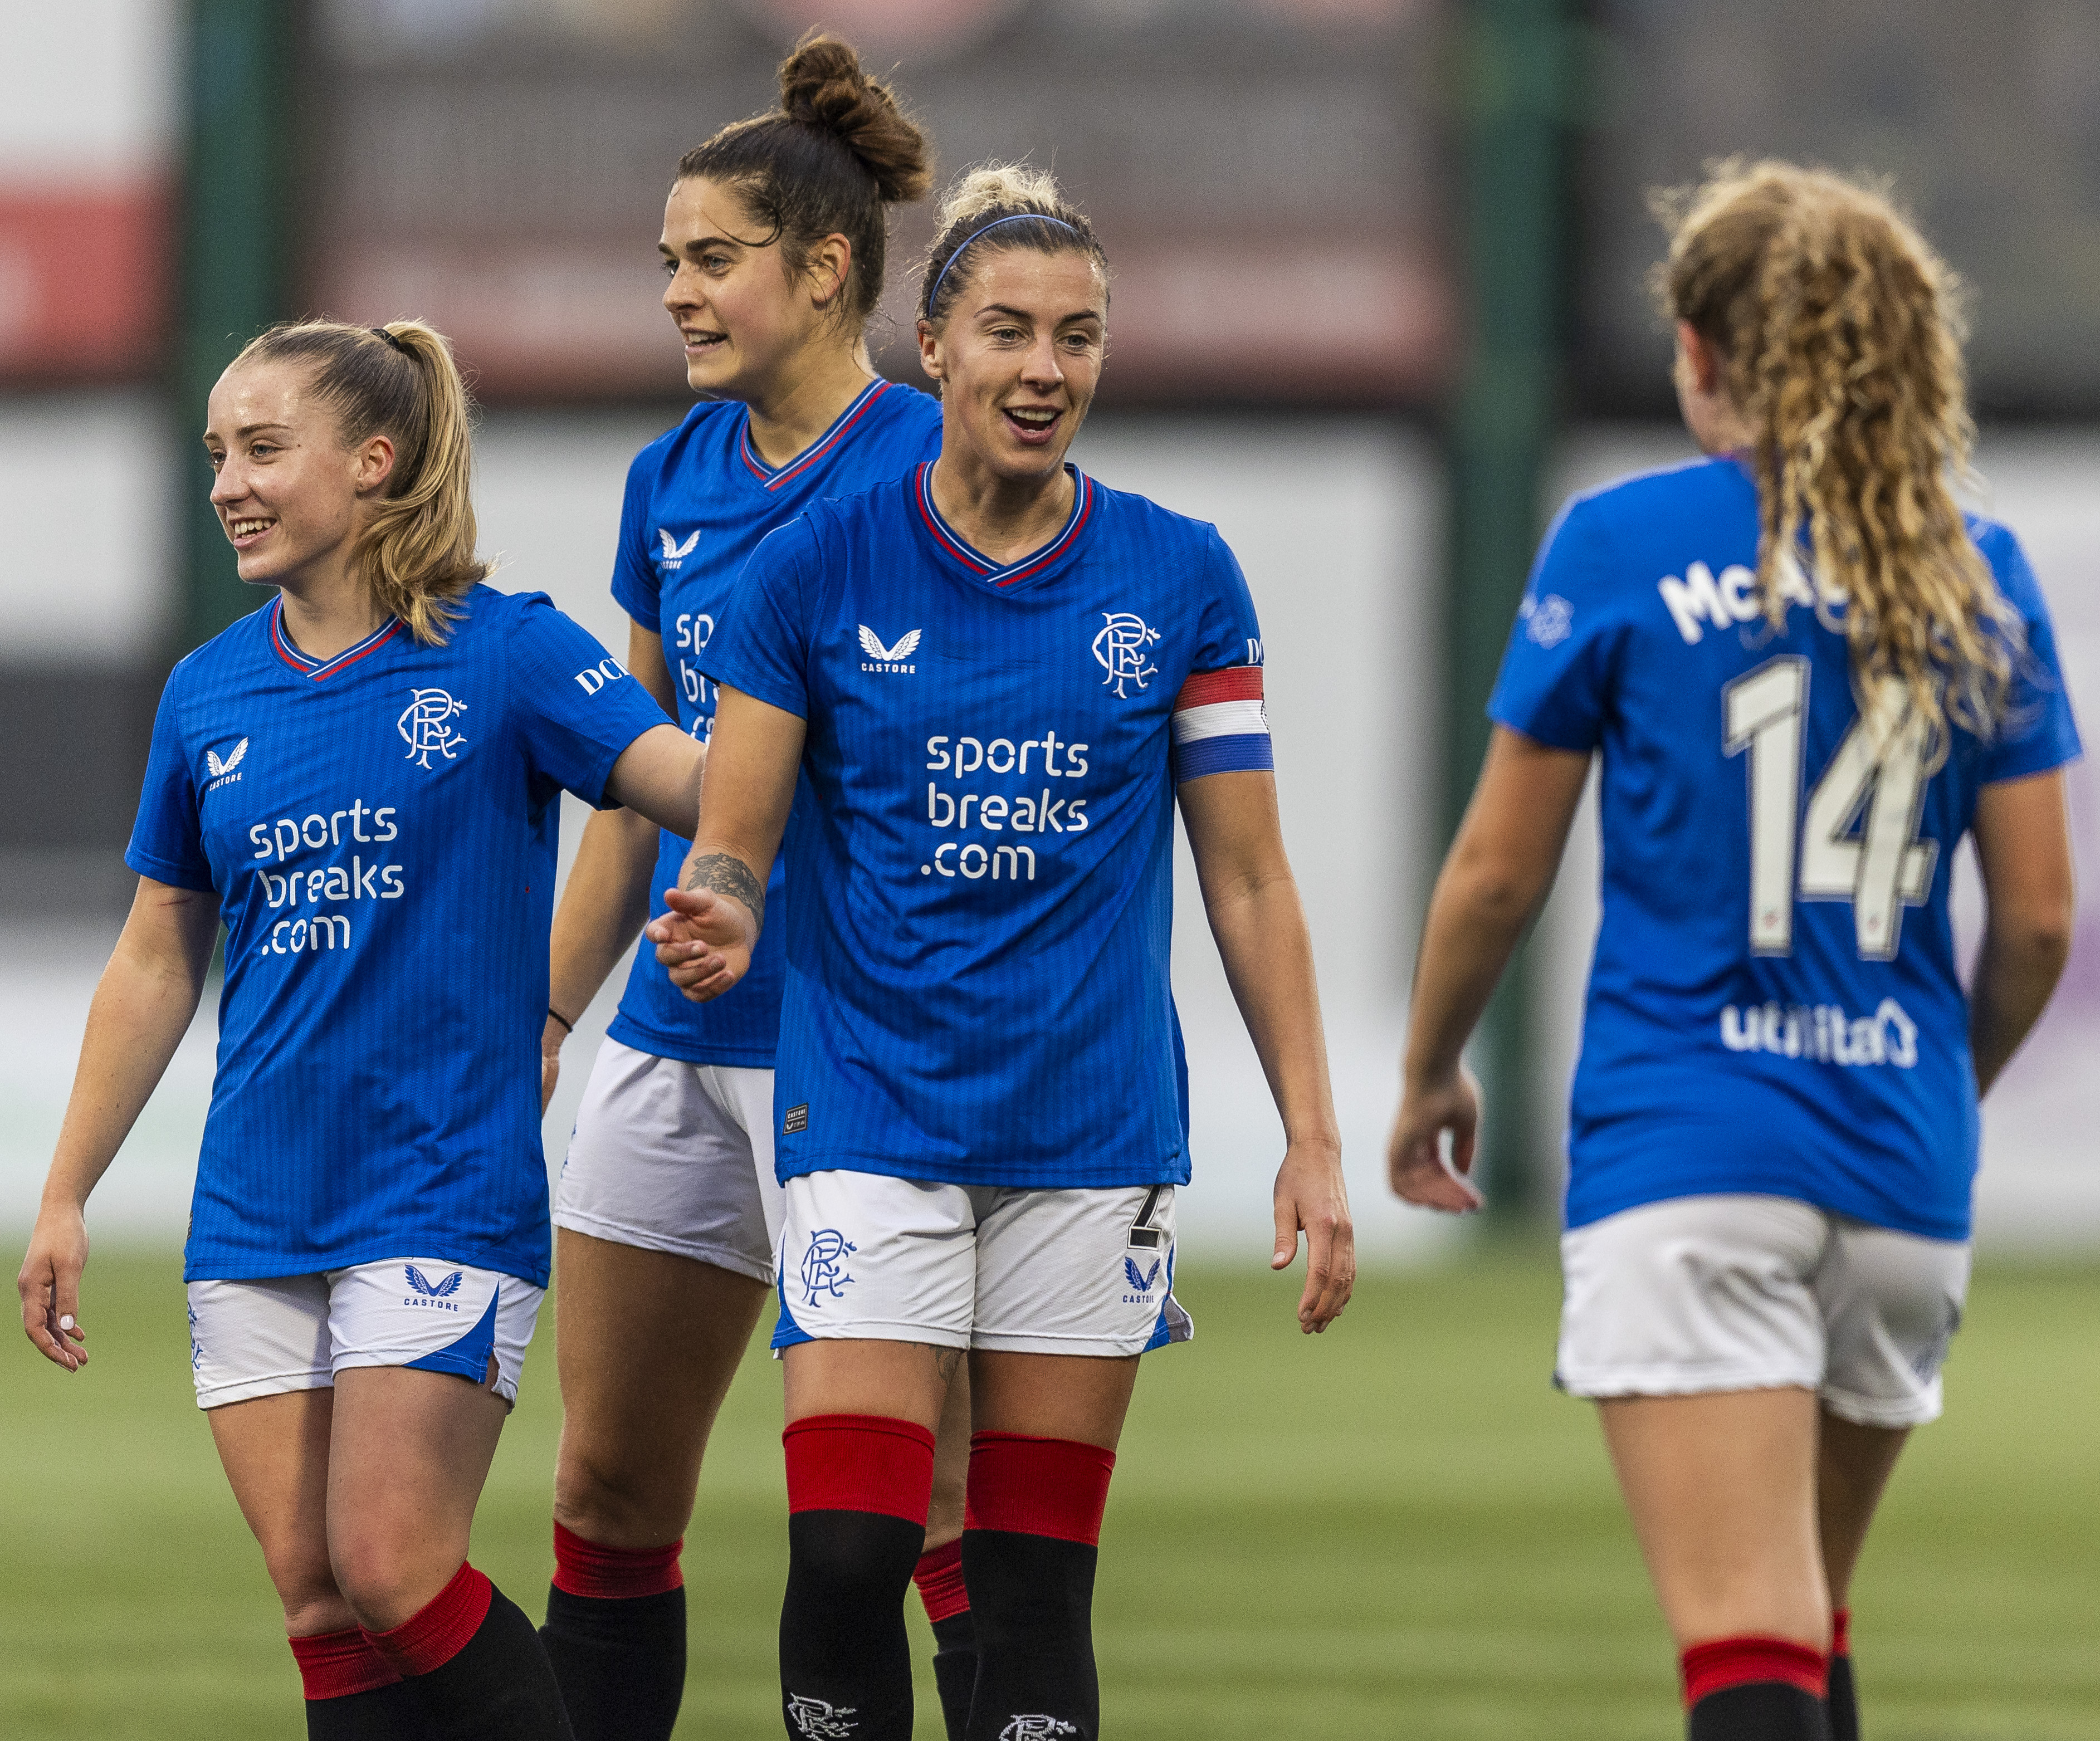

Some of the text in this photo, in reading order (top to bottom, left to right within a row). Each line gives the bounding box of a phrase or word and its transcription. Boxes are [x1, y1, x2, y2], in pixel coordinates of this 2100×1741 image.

[861, 663, 916, 674] CASTORE
[926, 731, 1088, 779] sports
[209, 772, 242, 792] CASTORE
[929, 782, 1088, 833] breaks
[1721, 654, 1939, 961] 14
[250, 799, 398, 861] sports
[258, 855, 404, 908] breaks
[921, 843, 1036, 881] .com
[262, 915, 350, 956] .com
[404, 1298, 458, 1312] CASTORE
